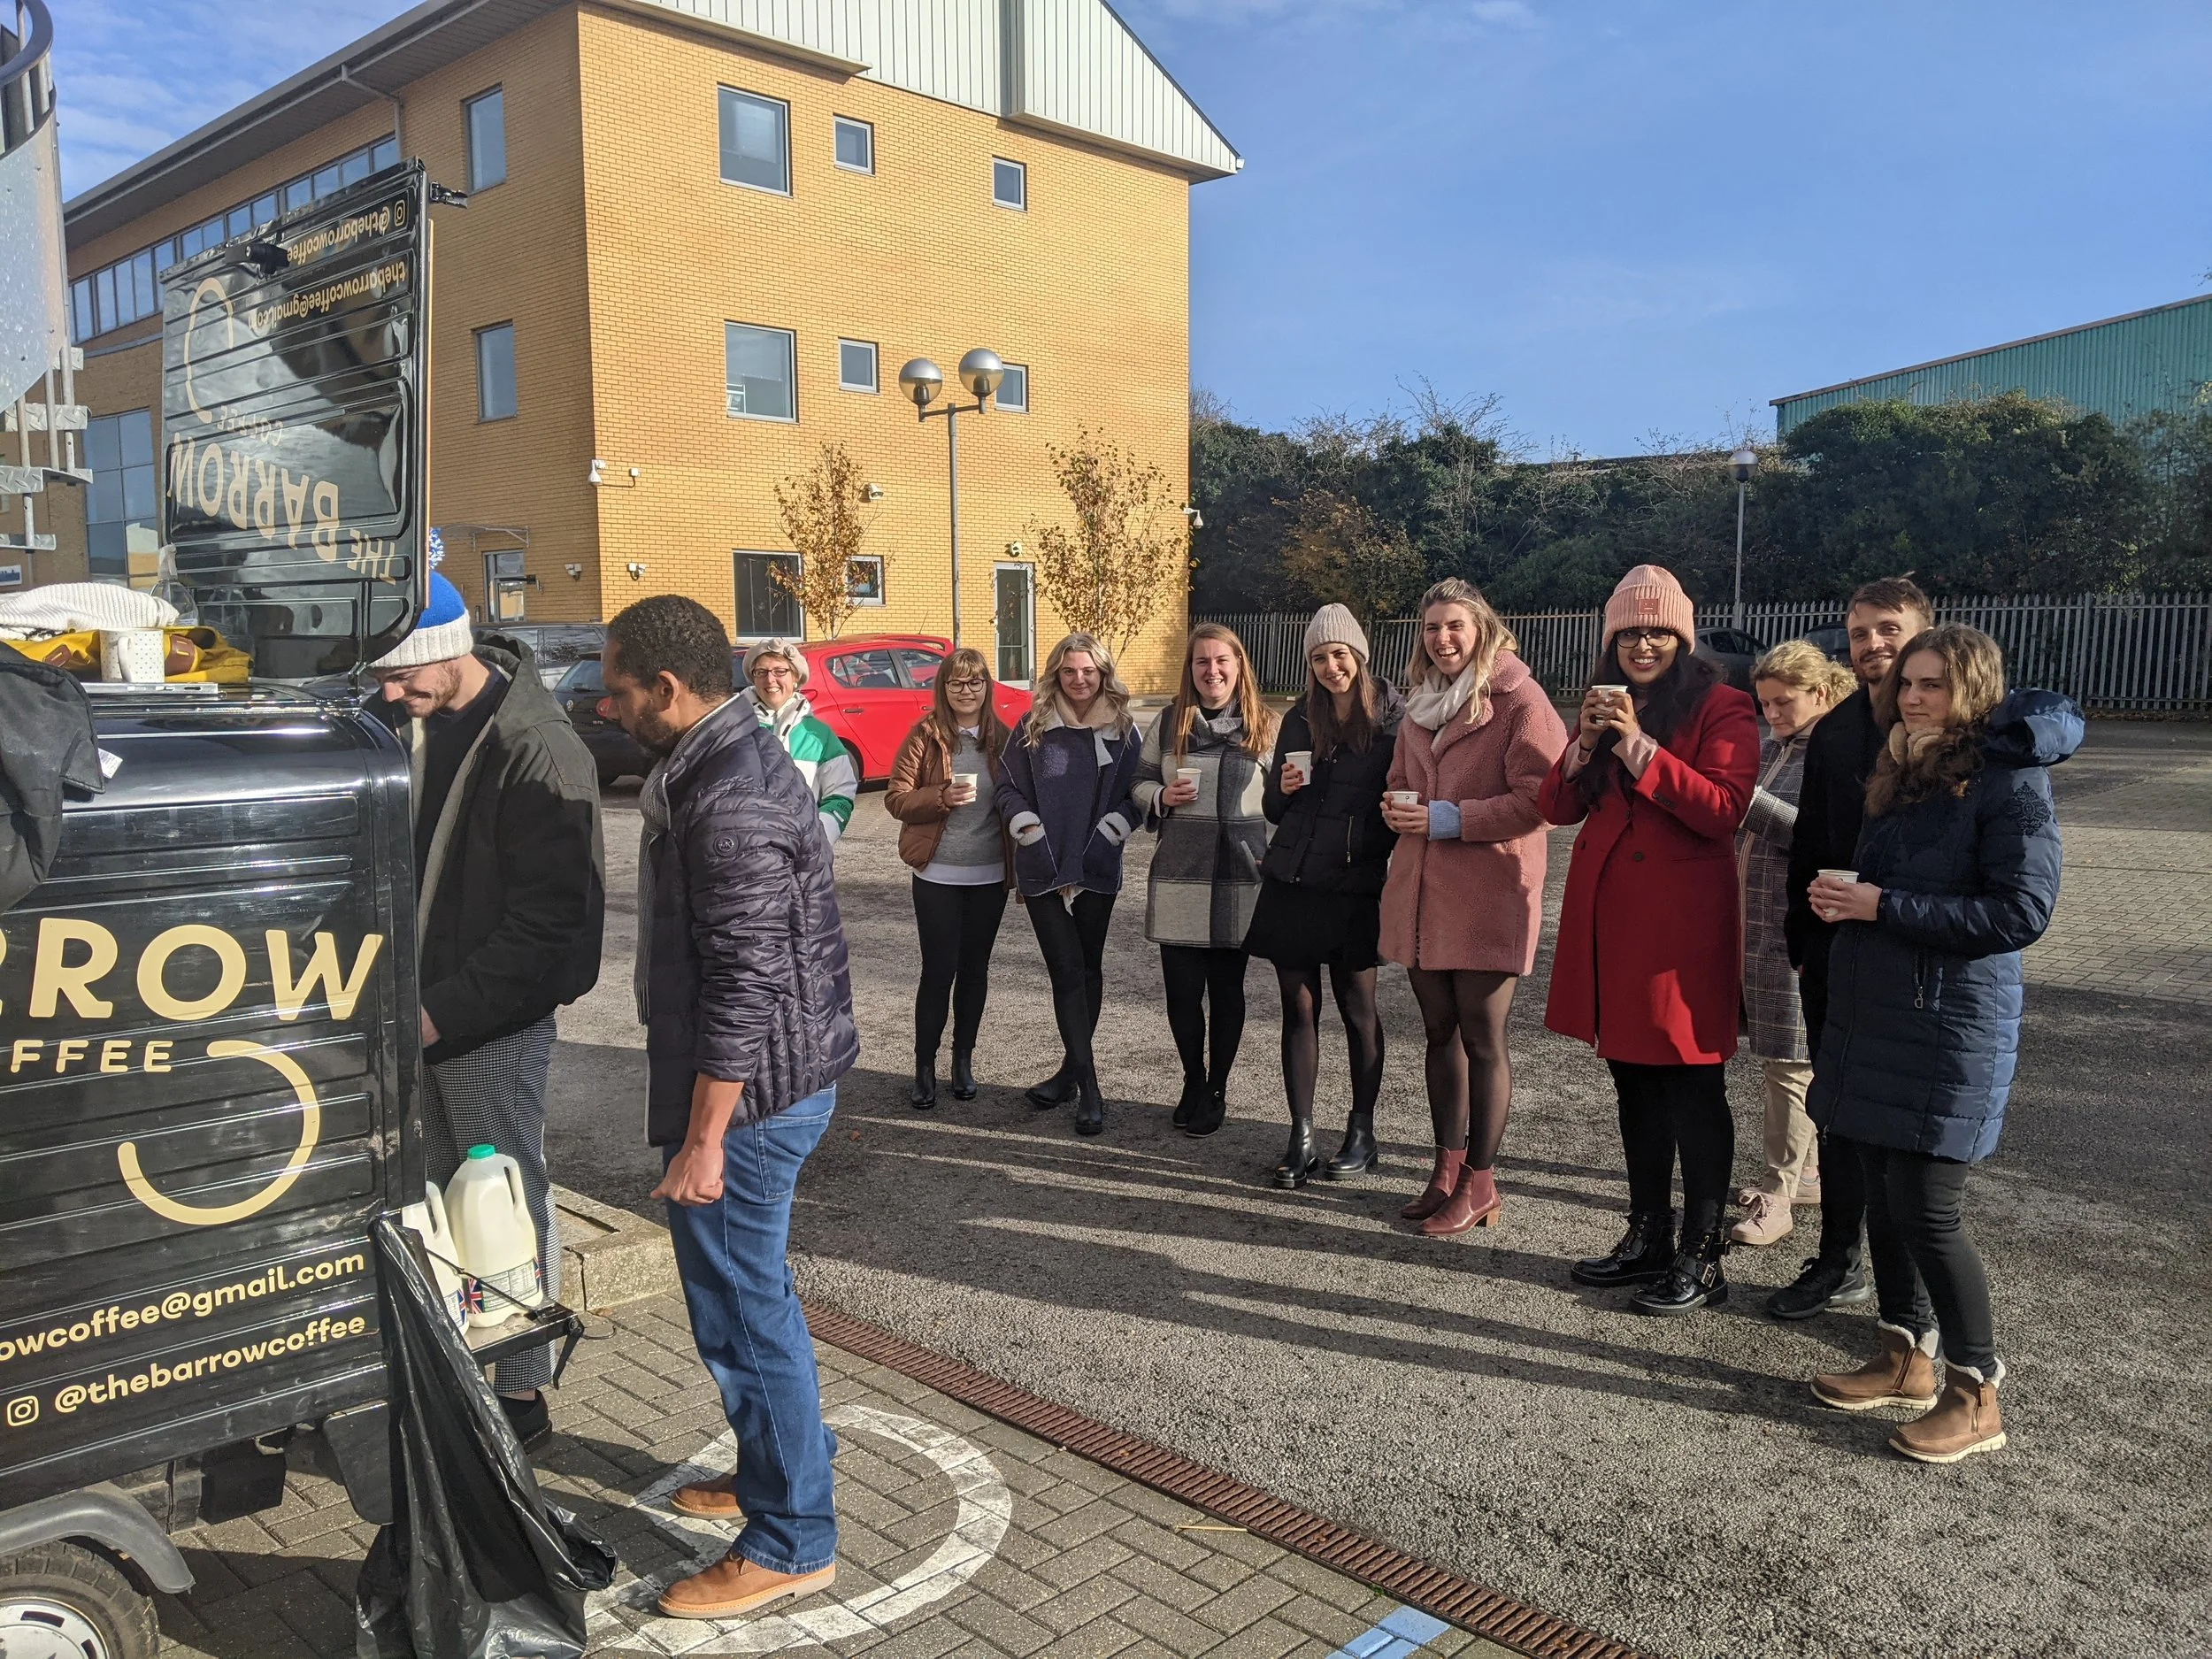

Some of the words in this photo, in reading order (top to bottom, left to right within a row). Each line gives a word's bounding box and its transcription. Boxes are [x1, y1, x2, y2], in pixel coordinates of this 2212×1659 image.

[286, 206, 390, 265] @thebarrowcoffee
[247, 261, 406, 330] thebarrowcoffee@gmail.com
[217, 405, 284, 447] COFFEE
[166, 432, 340, 563] BARROW
[347, 528, 396, 585] THE
[0, 917, 384, 1022] ROW
[11, 1039, 174, 1073] FFEE
[0, 1253, 365, 1362] owcoffee@gmail.com
[54, 1317, 365, 1414] @thebarrowcoffee
